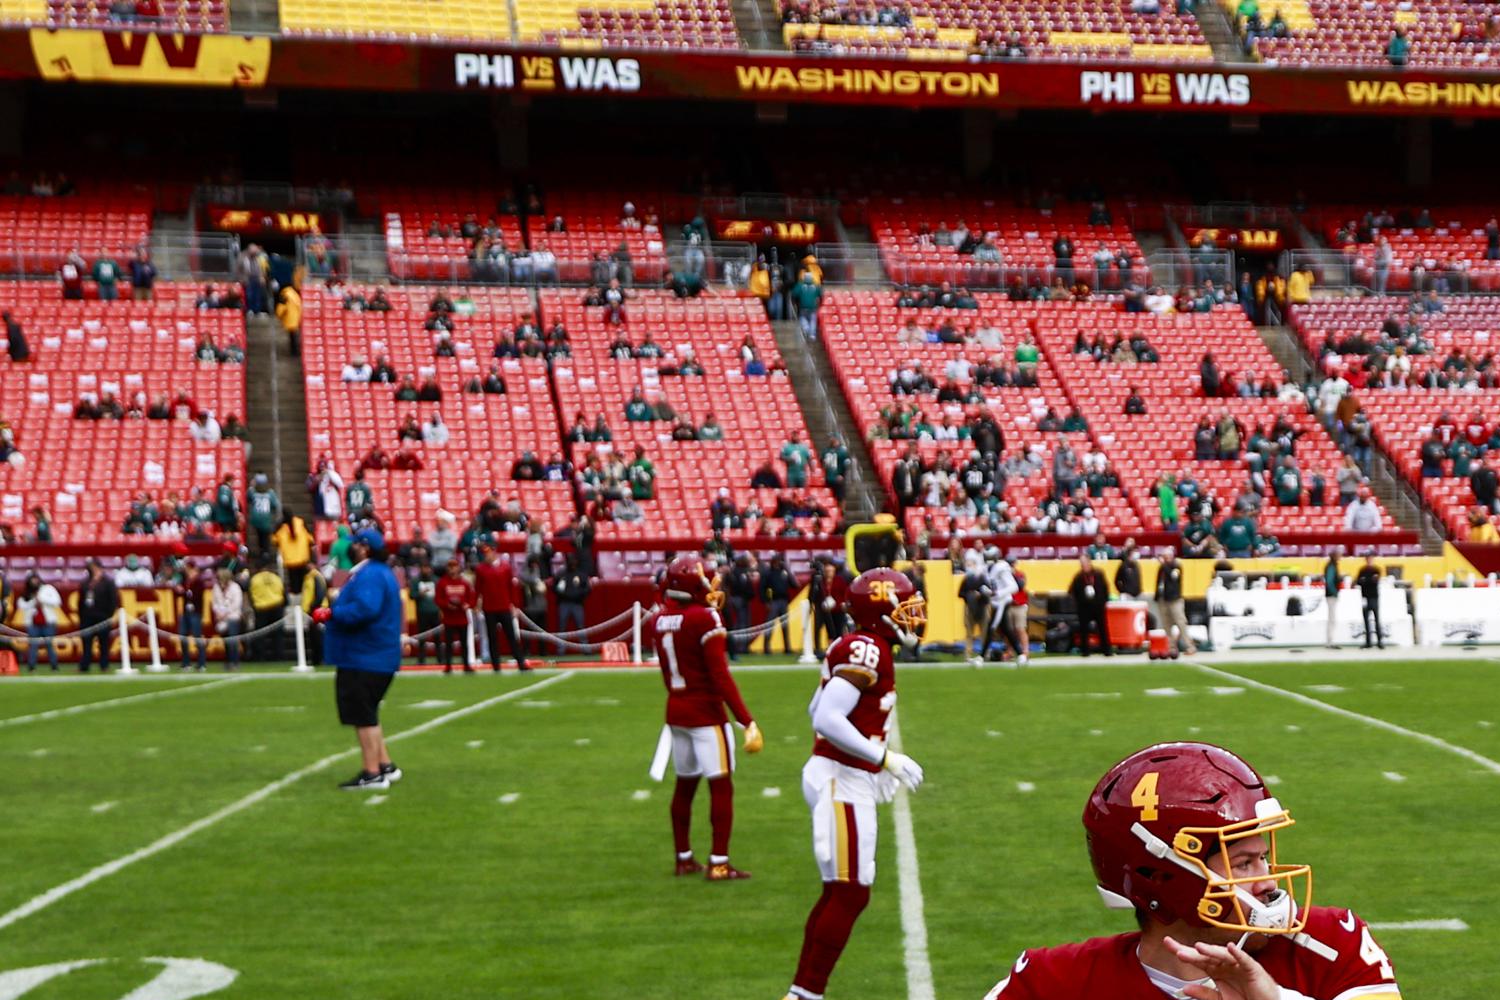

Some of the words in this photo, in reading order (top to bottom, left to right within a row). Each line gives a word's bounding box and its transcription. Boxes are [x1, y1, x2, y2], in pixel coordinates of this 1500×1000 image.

[455, 53, 514, 87] PHI
[560, 57, 641, 91] WAS
[736, 66, 999, 96] WASHINGTON
[1080, 71, 1134, 101] PHI
[1176, 73, 1250, 104] WAS
[869, 580, 896, 602] 36
[661, 632, 687, 690] 1
[849, 640, 880, 669] 36
[1131, 772, 1160, 822] 4
[1359, 926, 1395, 980] 4
